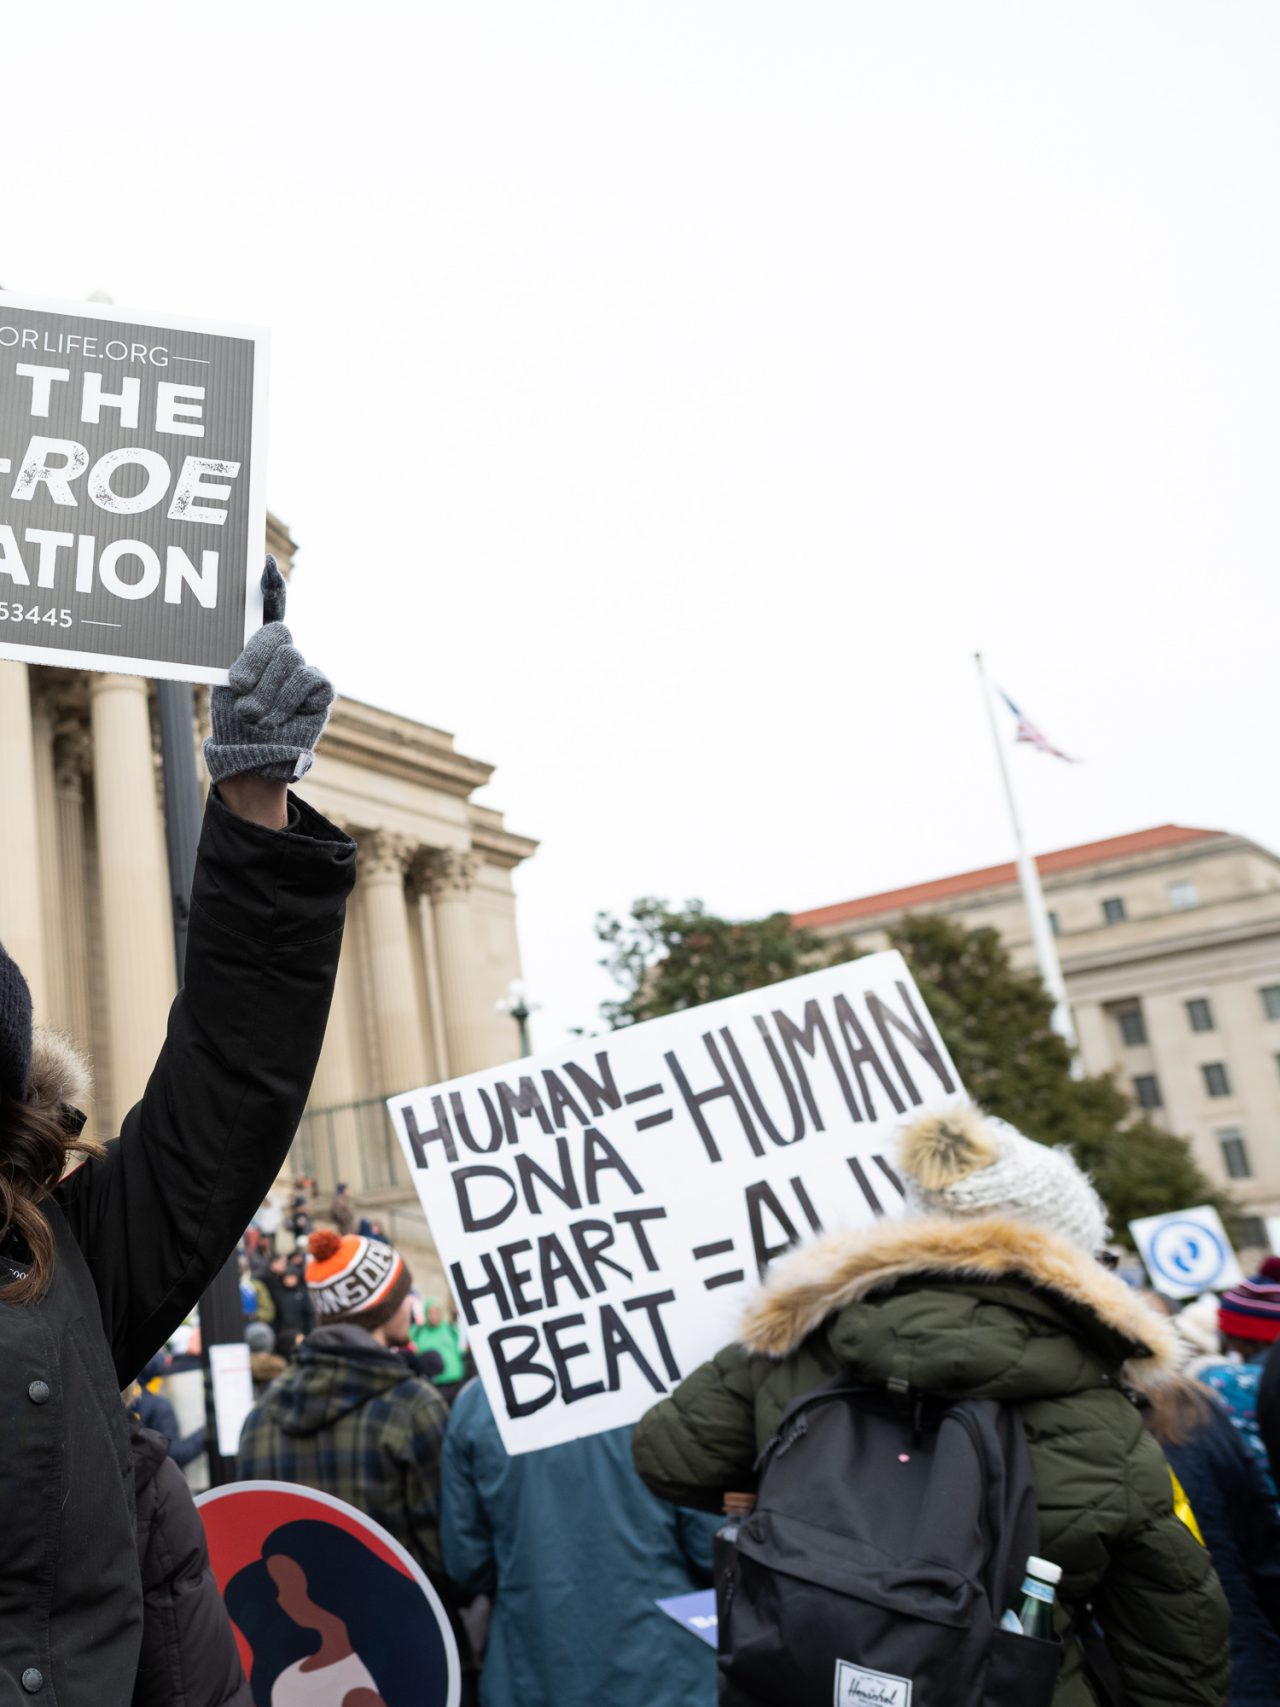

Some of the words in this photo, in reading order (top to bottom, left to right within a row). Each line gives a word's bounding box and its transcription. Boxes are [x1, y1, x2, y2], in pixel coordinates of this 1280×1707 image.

[16, 362, 205, 437] THE
[401, 1051, 622, 1169] HUMAN
[664, 981, 956, 1162] HUMAN
[451, 1127, 644, 1234] DNA
[450, 1207, 666, 1326] HEART
[488, 1290, 681, 1419] BEAT
